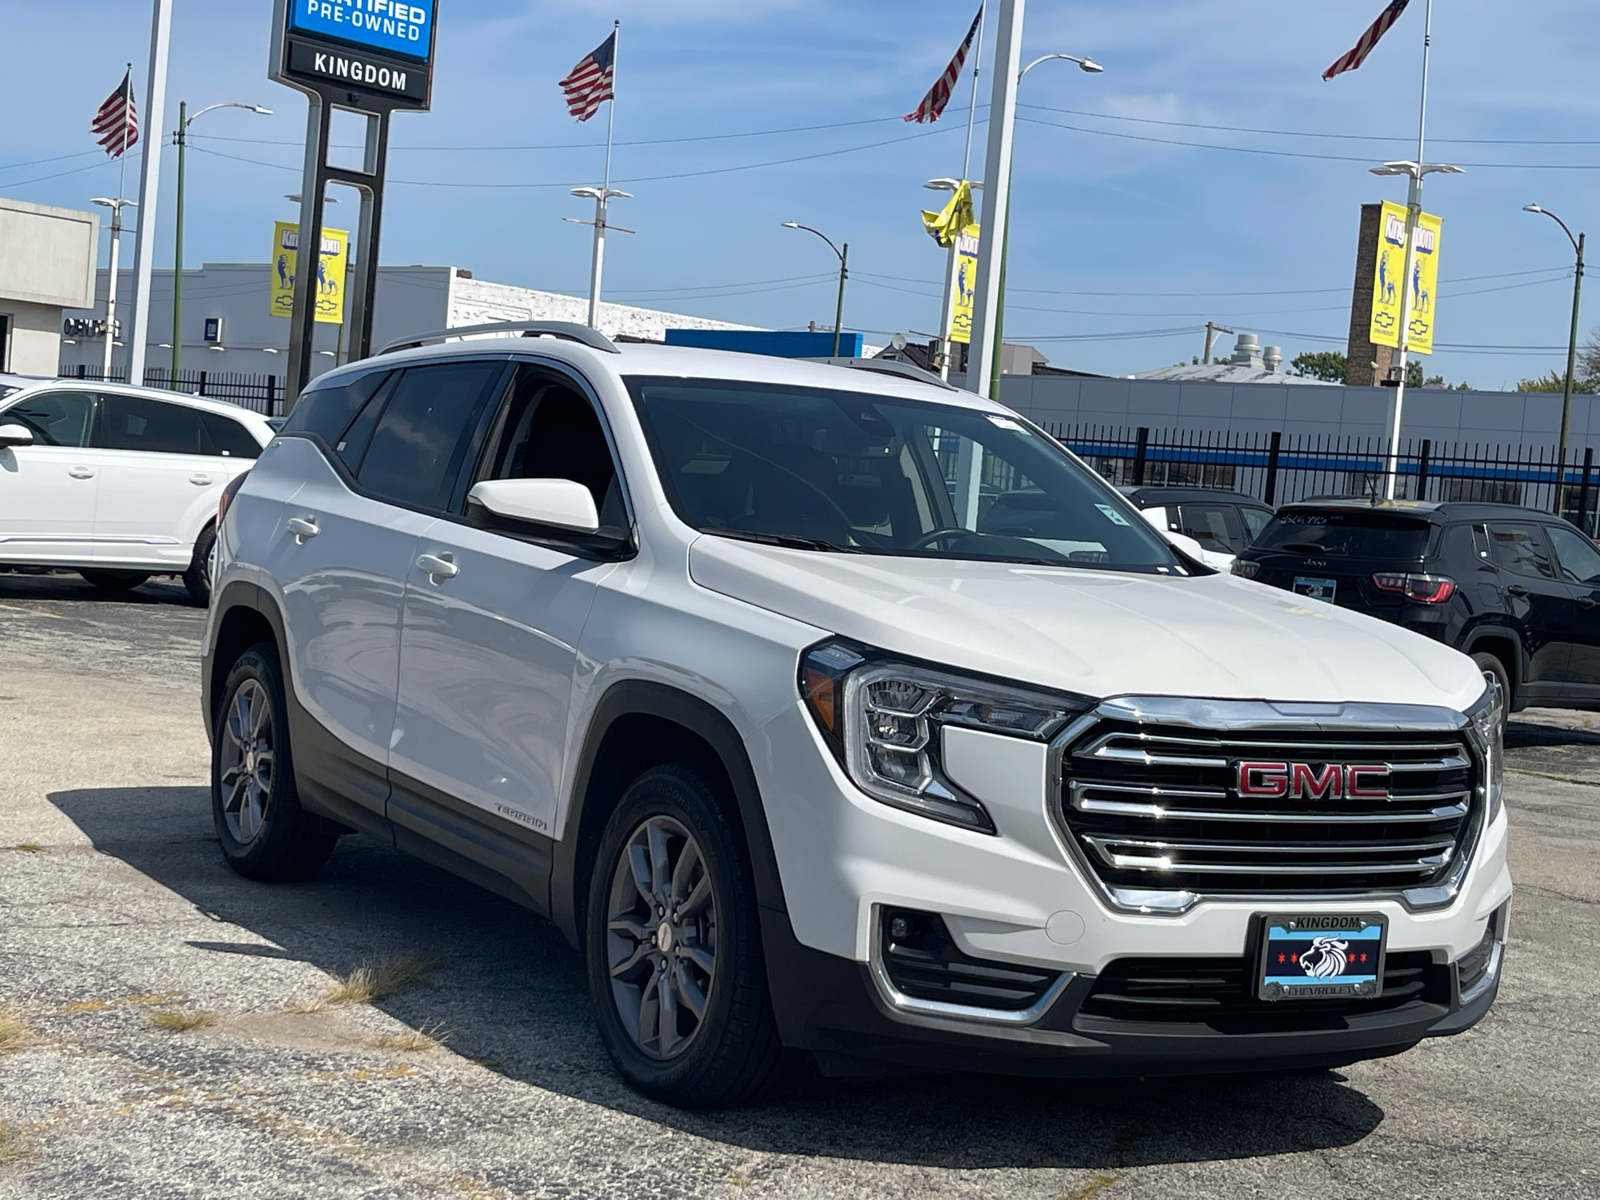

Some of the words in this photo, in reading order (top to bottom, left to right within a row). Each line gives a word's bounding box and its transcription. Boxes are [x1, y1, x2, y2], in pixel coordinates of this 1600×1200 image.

[307, 1, 419, 41] PRE-OWNED
[315, 53, 406, 90] KINGDOM
[281, 229, 299, 249] Kin
[1235, 761, 1391, 801] GMC
[495, 802, 547, 830] TERRAIN
[1296, 916, 1360, 929] KINGDOM
[1288, 985, 1352, 996] CHEVROLET
